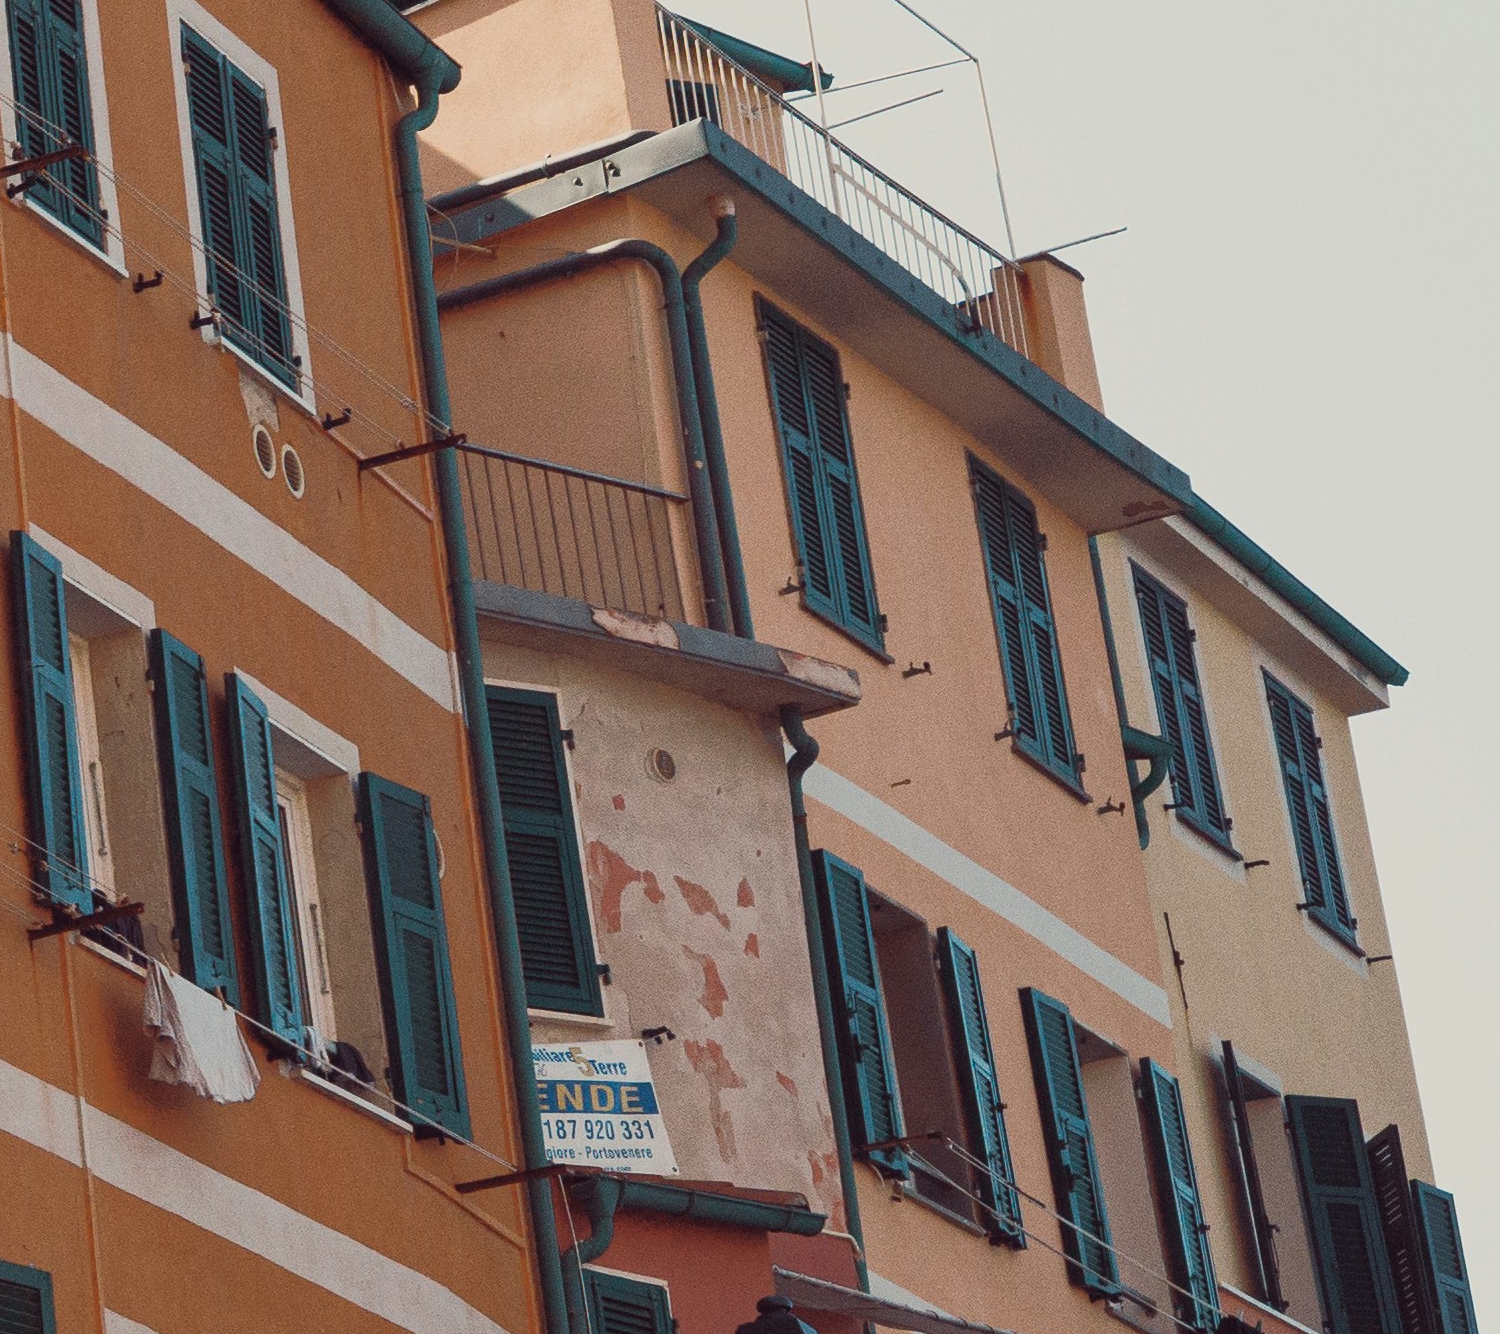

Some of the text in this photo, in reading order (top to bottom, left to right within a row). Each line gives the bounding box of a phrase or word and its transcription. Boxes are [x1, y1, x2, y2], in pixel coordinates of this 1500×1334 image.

[569, 1046, 594, 1077] 5
[591, 1060, 628, 1076] Terre
[585, 1119, 615, 1140] 920
[620, 1119, 654, 1139] 331
[586, 1146, 654, 1160] Portovenere
